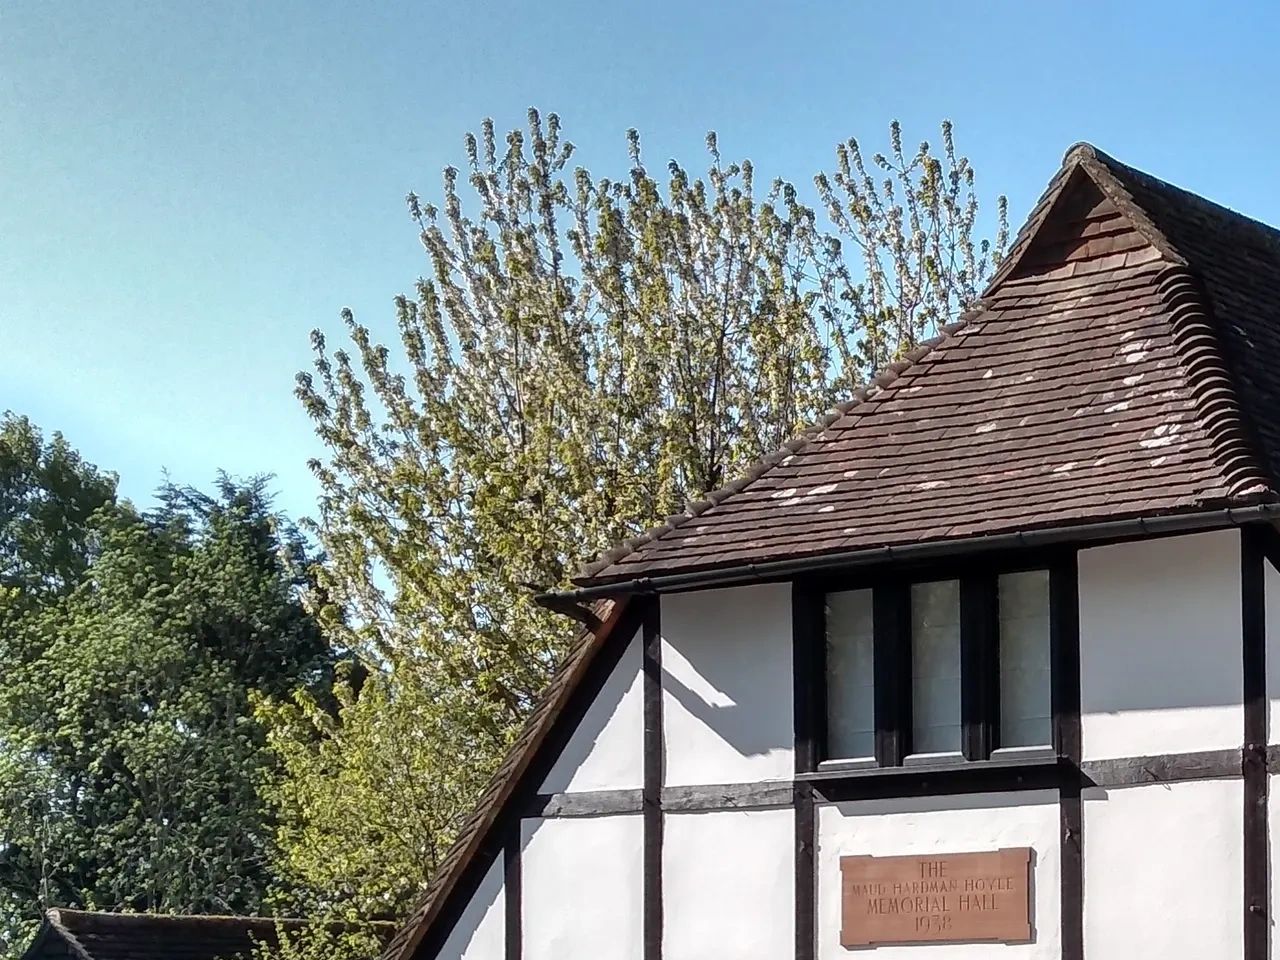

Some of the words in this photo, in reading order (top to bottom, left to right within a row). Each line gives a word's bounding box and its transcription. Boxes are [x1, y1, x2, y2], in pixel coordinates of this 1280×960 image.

[919, 861, 948, 878] THE
[893, 880, 958, 895] HARDMAN
[965, 877, 1014, 892] HOYLE
[867, 896, 950, 915] MEMORIAL
[959, 894, 1001, 911] HALL
